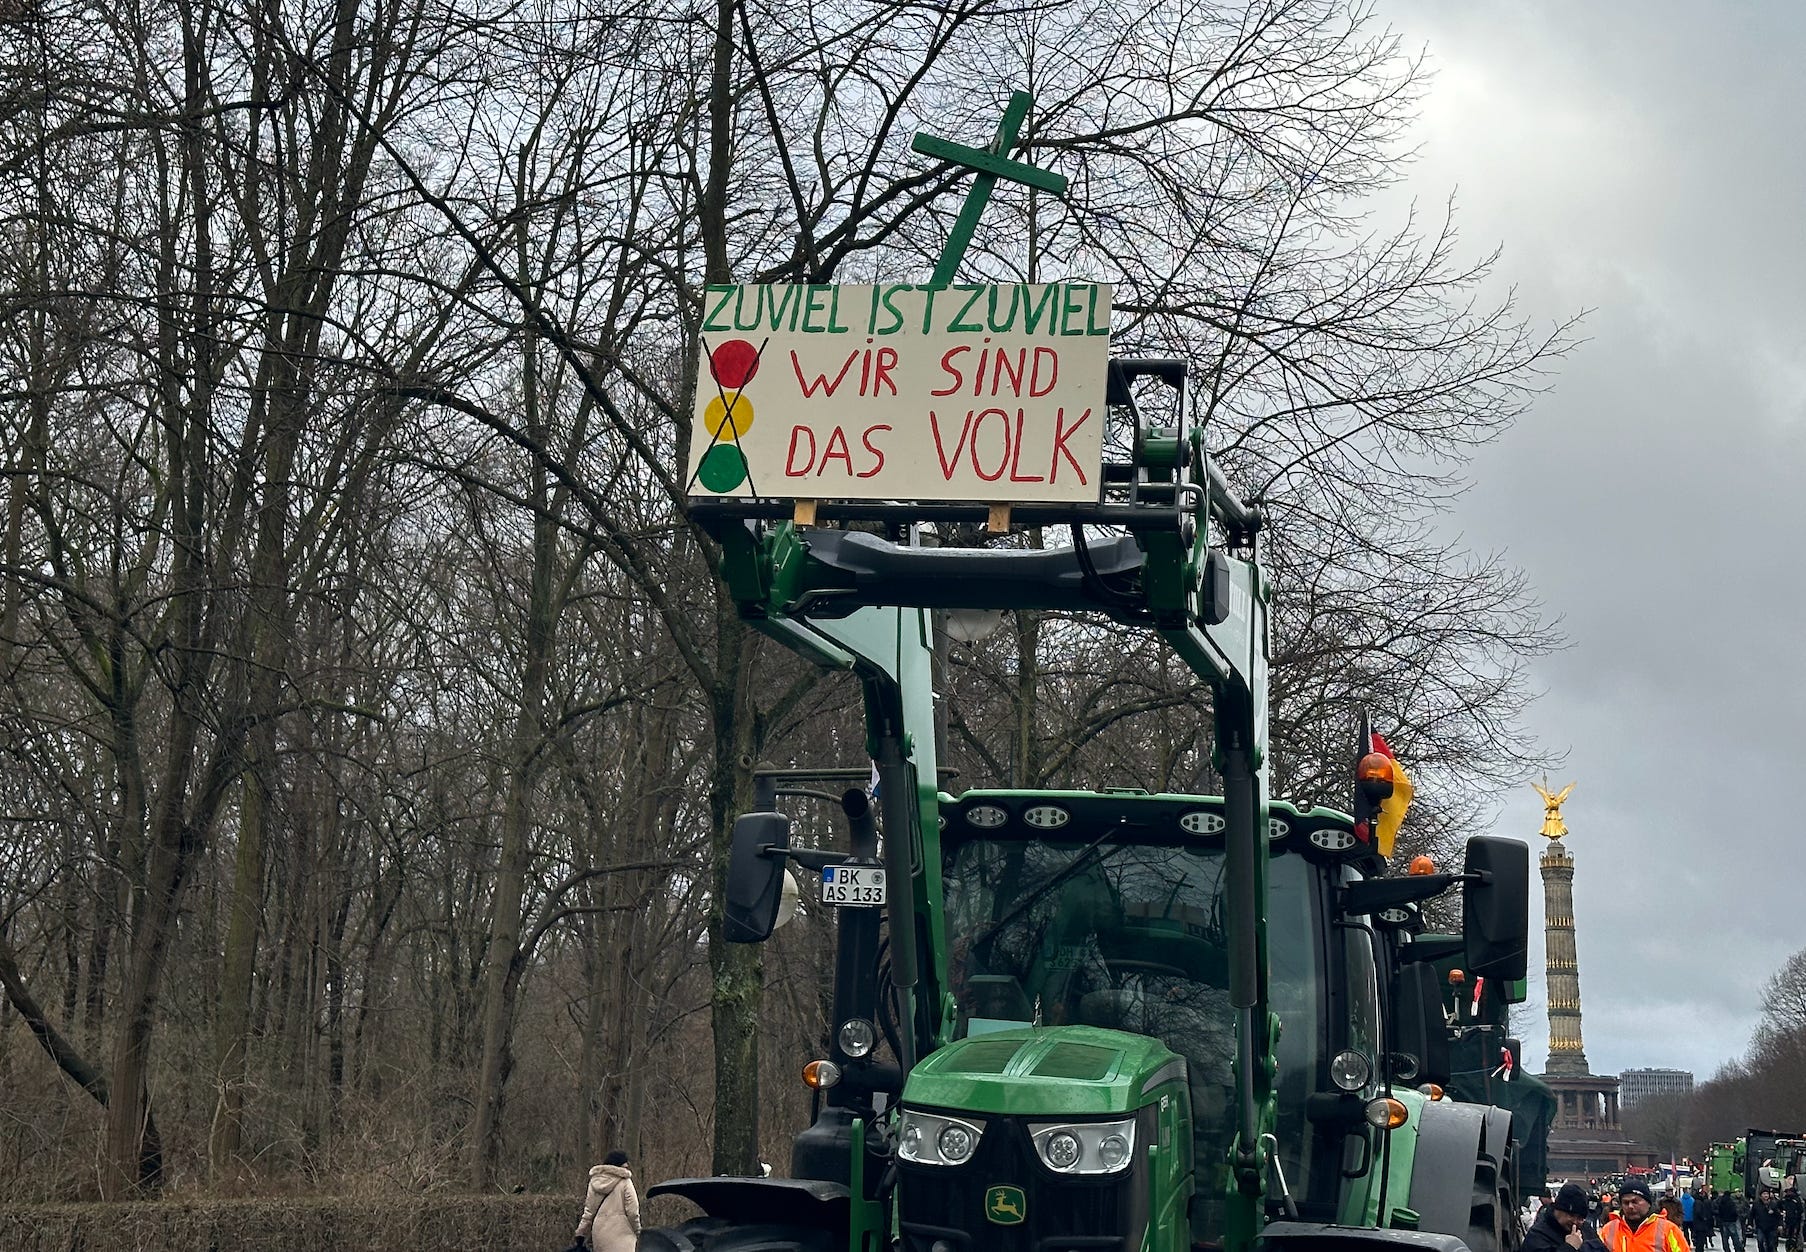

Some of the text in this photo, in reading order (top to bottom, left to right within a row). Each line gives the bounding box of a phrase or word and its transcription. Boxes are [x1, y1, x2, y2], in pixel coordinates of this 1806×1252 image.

[703, 284, 1110, 337] ZUVIEL IST ZUVIEL
[786, 408, 1092, 486] DAS VOLK
[826, 886, 882, 902] AS 133
[840, 870, 859, 885] BK
